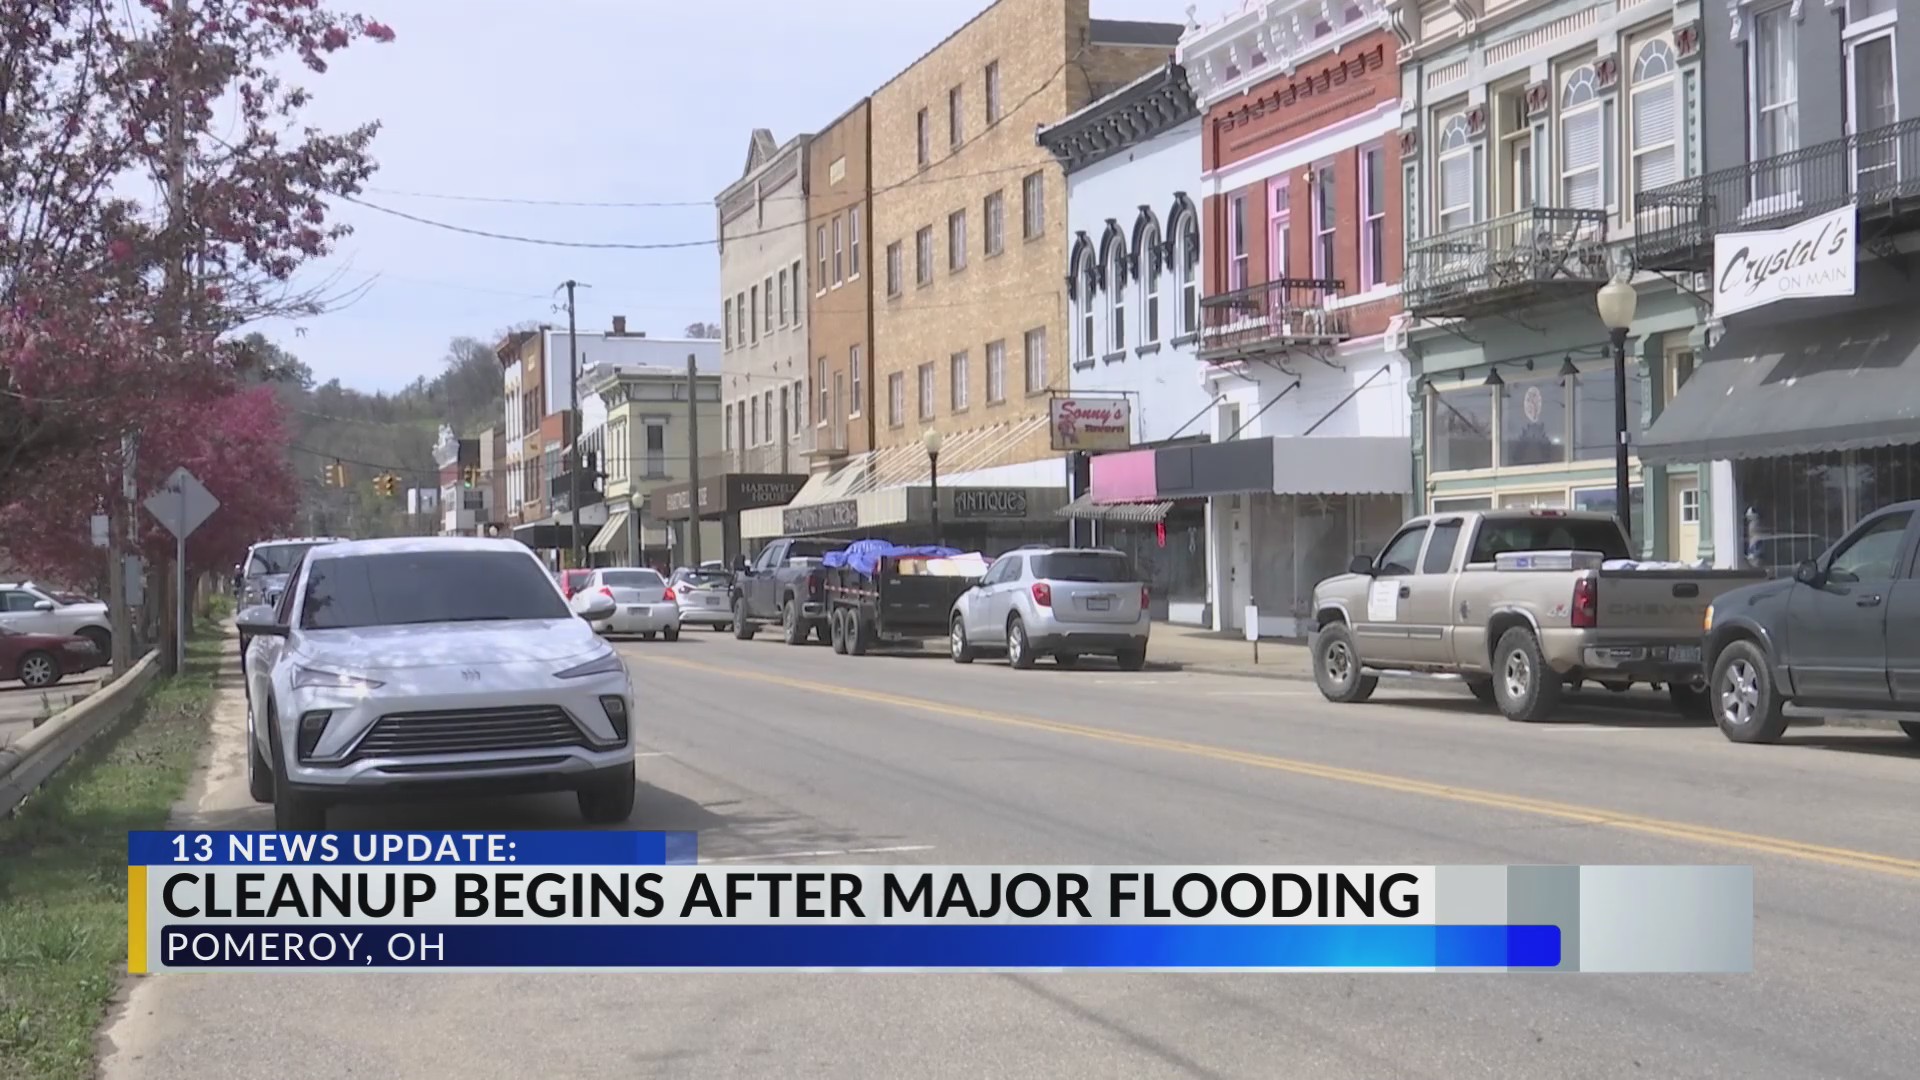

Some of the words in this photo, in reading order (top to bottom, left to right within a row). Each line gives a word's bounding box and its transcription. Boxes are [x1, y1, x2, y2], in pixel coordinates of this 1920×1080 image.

[1719, 217, 1848, 297] Crystal's
[1778, 276, 1801, 292] ON
[1806, 266, 1847, 288] MAIN
[1061, 401, 1122, 425] Sonny's
[741, 483, 796, 493] HARTWELL
[751, 492, 786, 502] HOUSE
[956, 491, 1026, 513] ANTIQUES
